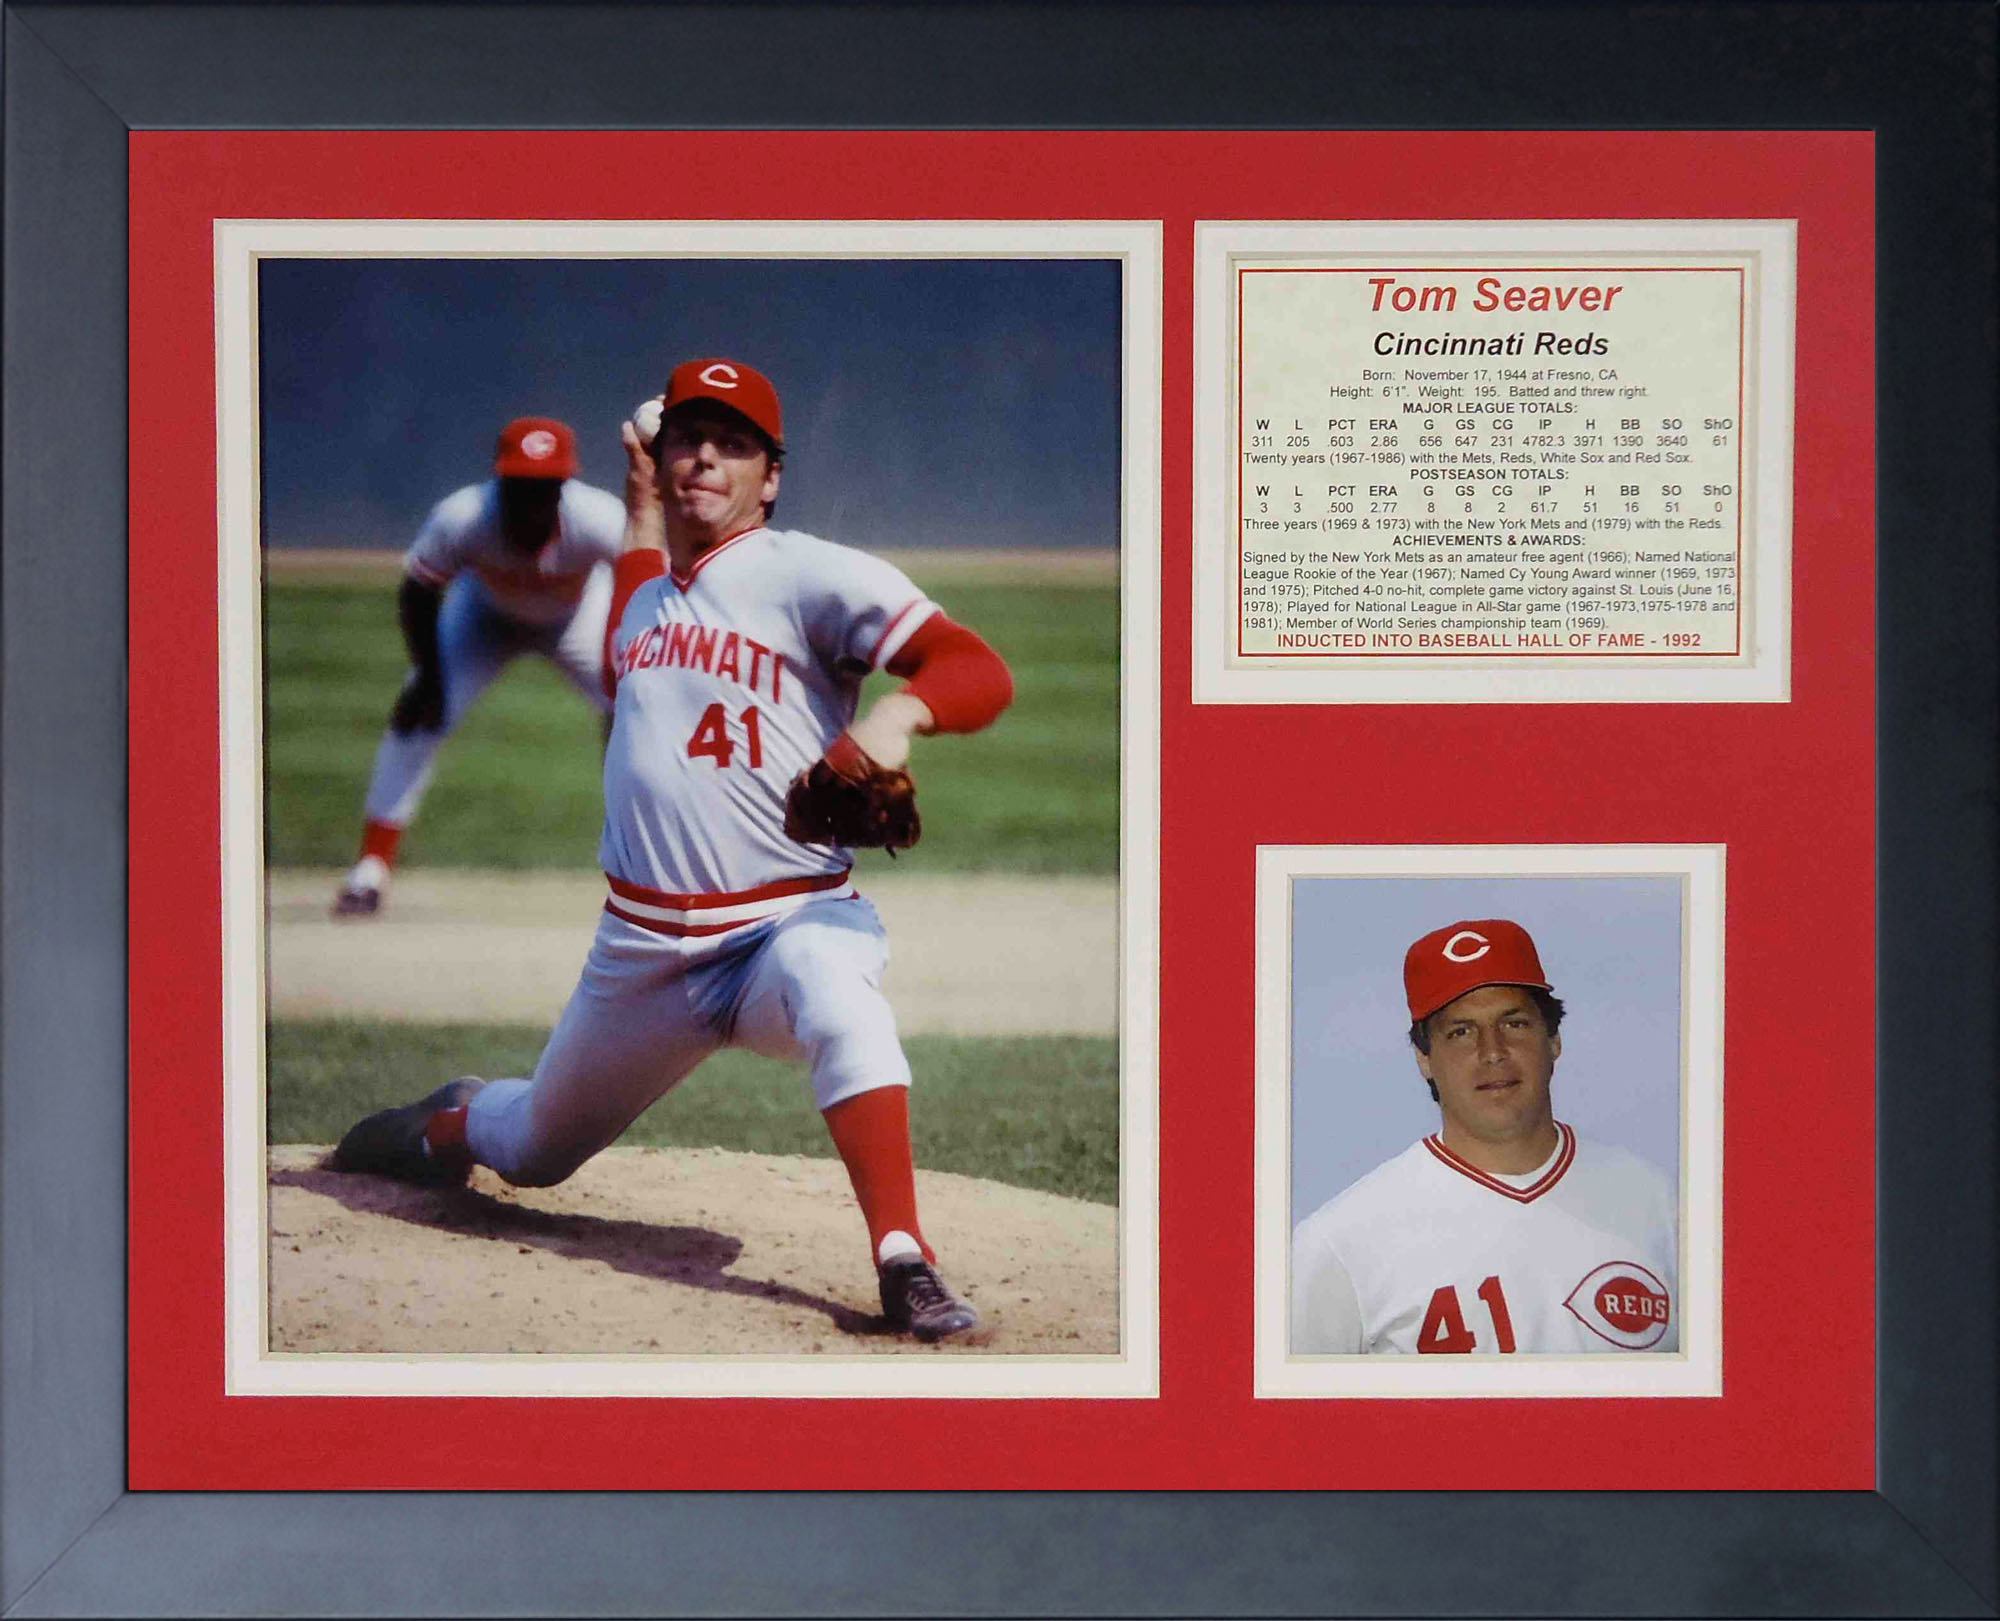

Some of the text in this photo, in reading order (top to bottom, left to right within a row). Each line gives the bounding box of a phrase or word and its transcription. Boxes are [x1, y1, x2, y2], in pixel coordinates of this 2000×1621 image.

[1368, 276, 1623, 312] Tom Seaver
[1374, 332, 1610, 356] Cincinnati Reds
[1363, 369, 1618, 382] Born: November 17, 1944 Fresno, CA
[1330, 386, 1615, 400] Height: Weight: Batted and threw
[1403, 402, 1578, 414] MAJOR LEAGUE TOTALS:
[1256, 418, 1733, 430] W L PCT ERA G GS CG IP H BB SO ShO
[1252, 435, 1644, 447] 311 205 .603 2.86 656 647 231 4782.3 3971 1390
[1243, 452, 1661, 466] Twenty years (1967-1986) with the Mets, Reds, White Sox Red
[1410, 468, 1569, 480] POSTSEASON TOTALS:
[1255, 485, 1732, 497] W L PCT ERA G GS CG IP H BB SO ShO
[1327, 501, 1679, 513] .500 2.77 8 8 2 61.7 51 16 51
[1243, 518, 1684, 532] Three years (1969 1973) with the New York Mets and (1979) with the
[1392, 534, 1586, 546] ACHIEVEMENTS & AWARDS:
[1243, 551, 1735, 565] Signed by the New York Mets amateur free agent (1966); Named National
[1243, 567, 1735, 582] League Rookie the Year (1967); Named Cy Young Award winner 1973
[1243, 584, 1674, 598] and 1975); Pitched no-hit, complete game victory against Louis
[1244, 601, 1282, 614] 1978);
[1287, 601, 1329, 614] Played
[1334, 601, 1351, 612] for
[1355, 601, 1406, 612] National
[1411, 601, 1457, 614] League
[1476, 601, 1522, 612] All-Star
[1526, 603, 1561, 614] game
[1244, 617, 1609, 631] 1981); Member World Series championship team (1969).
[1278, 633, 1701, 647] INDUCTED INTO BASEBALL HALL OF FAME 1992
[687, 703, 763, 769] 41
[1442, 931, 1491, 962] C
[1604, 1293, 1667, 1320] REDS
[1417, 1275, 1517, 1354] 41
